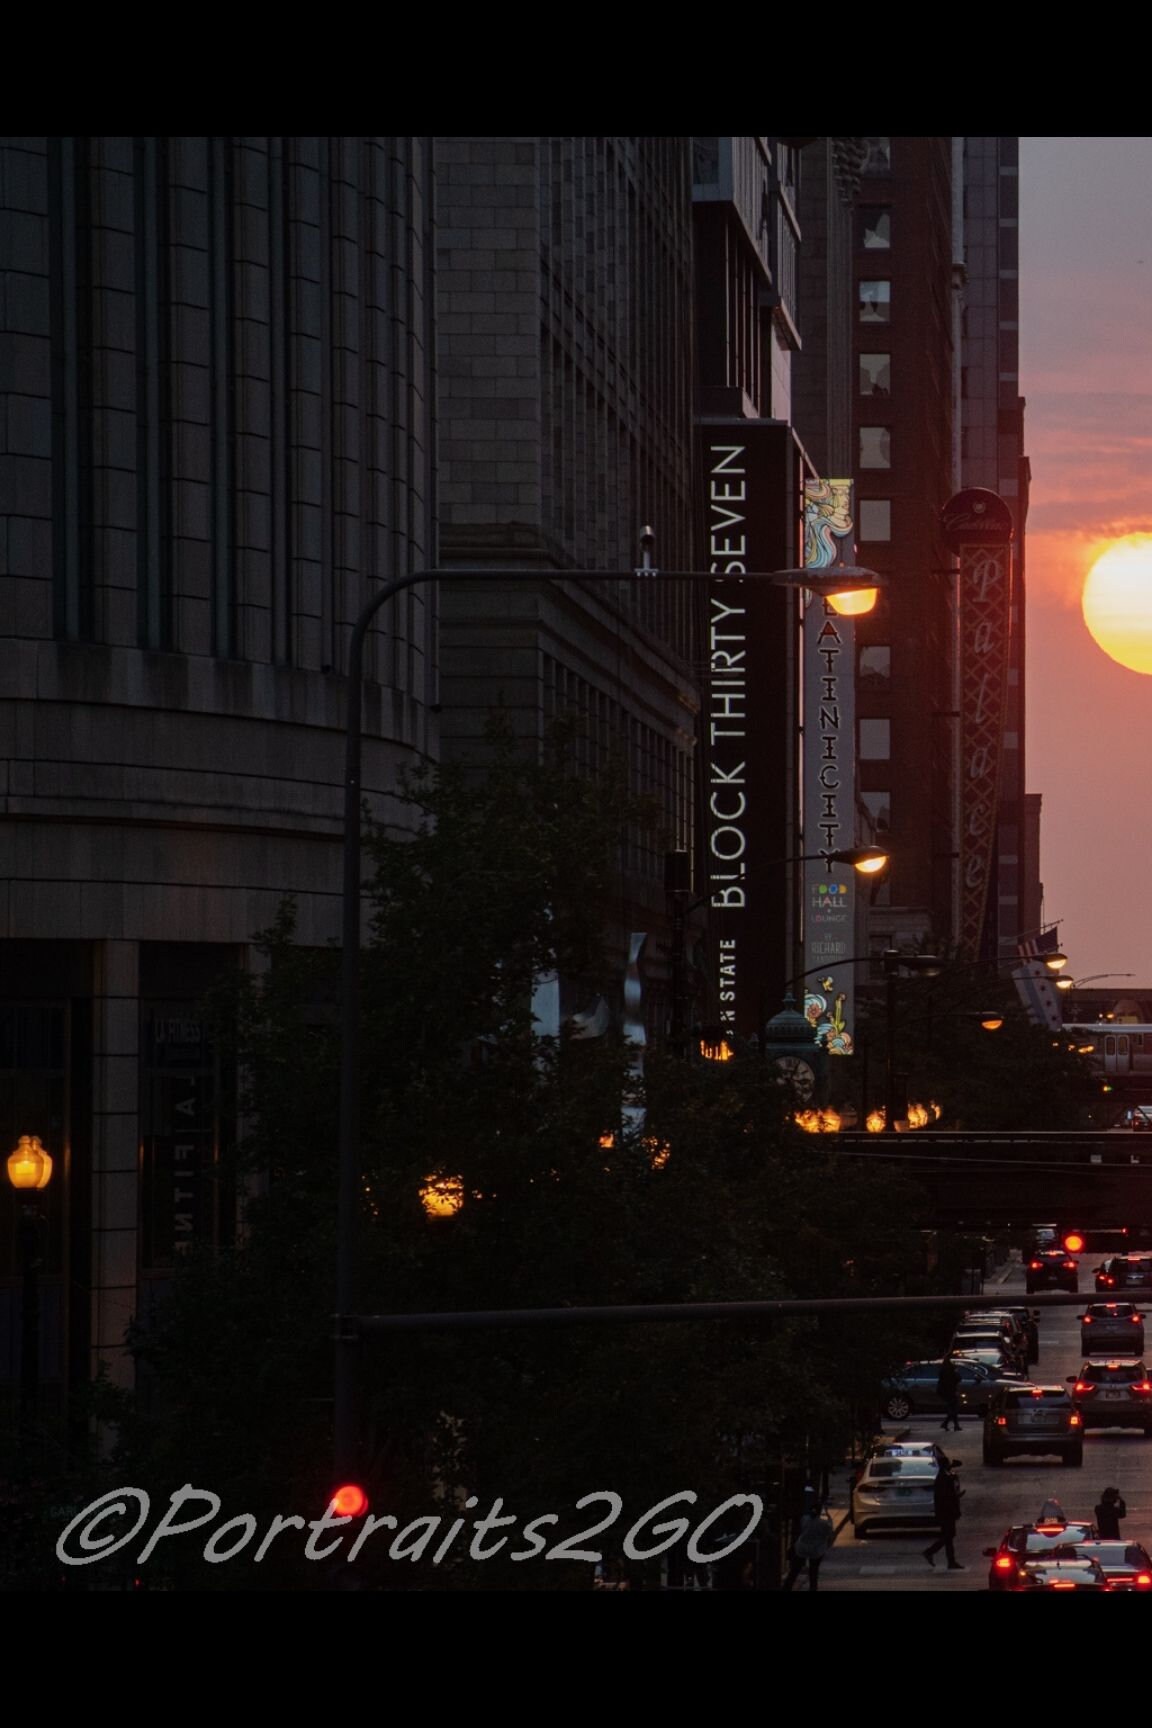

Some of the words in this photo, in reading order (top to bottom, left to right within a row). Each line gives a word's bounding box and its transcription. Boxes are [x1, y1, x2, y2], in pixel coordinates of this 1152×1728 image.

[710, 445, 747, 583] SEVEN
[710, 599, 747, 746] THIRTY
[964, 558, 1001, 889] Palace
[710, 761, 747, 907] BLOCK
[811, 883, 848, 895] FOOD
[811, 895, 848, 908] HALL
[719, 939, 736, 1001] STATE
